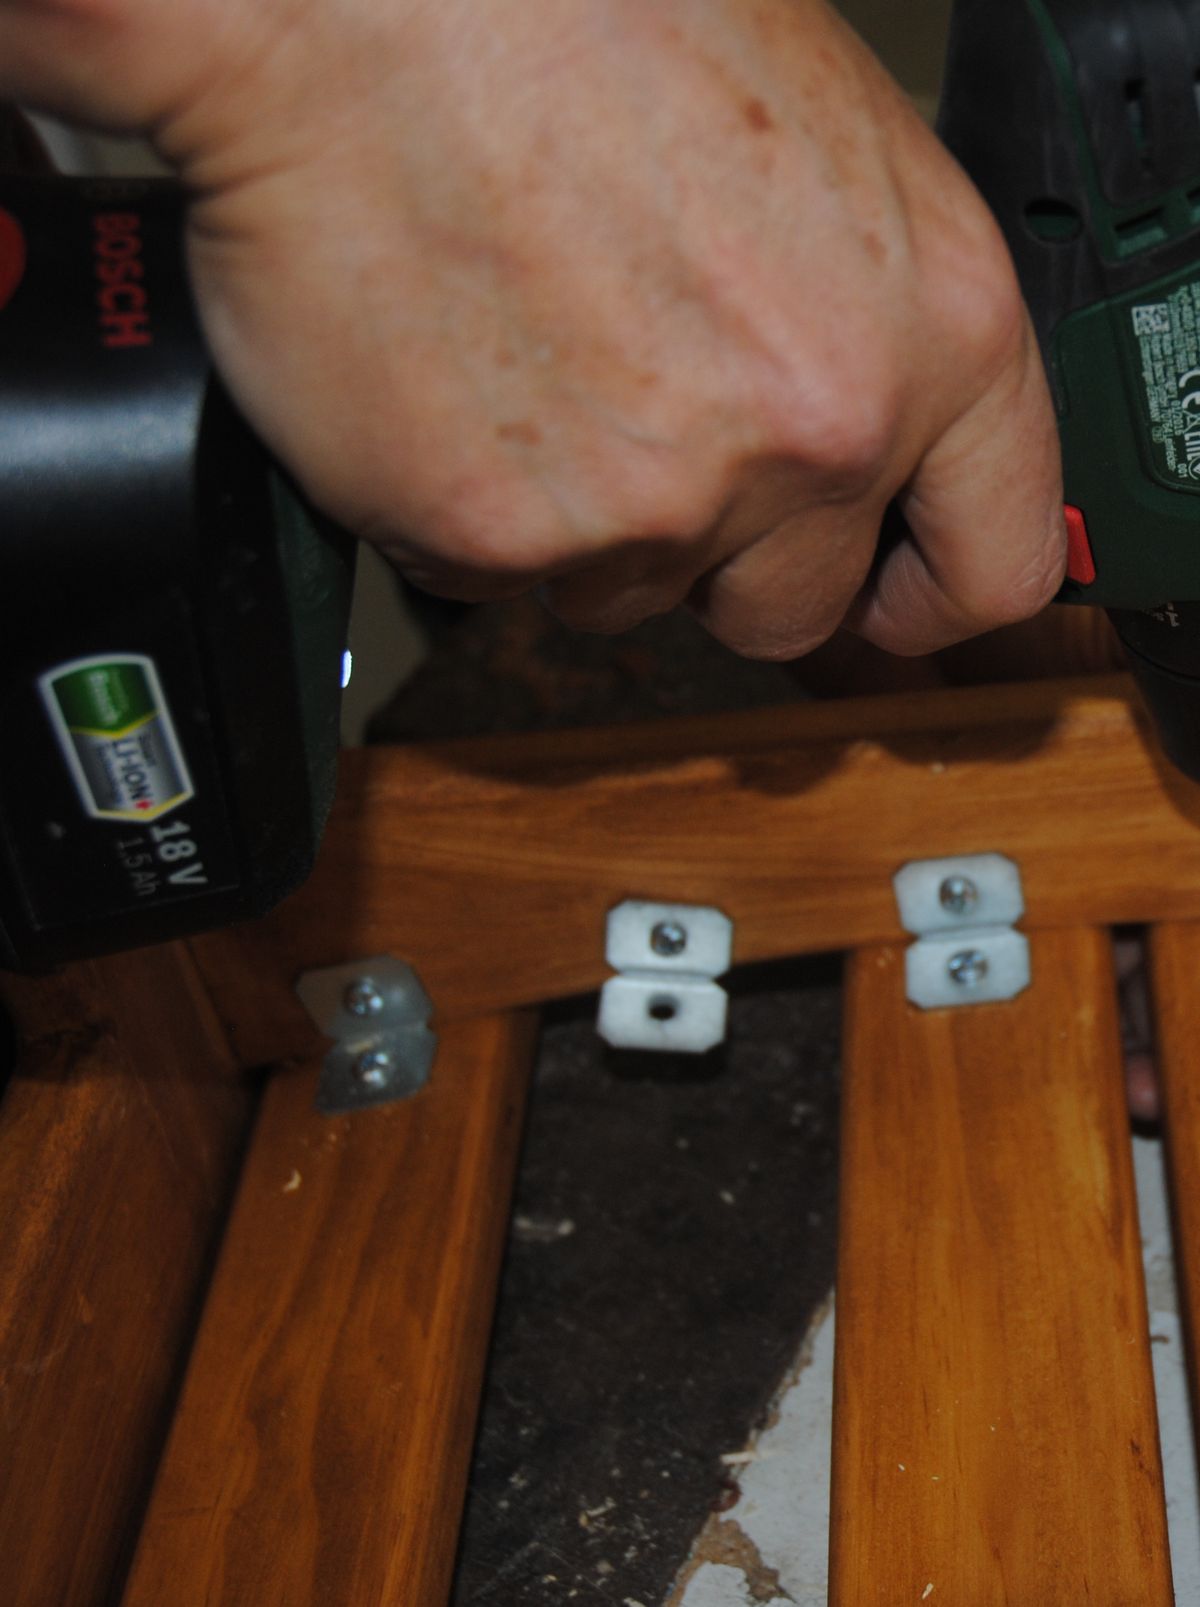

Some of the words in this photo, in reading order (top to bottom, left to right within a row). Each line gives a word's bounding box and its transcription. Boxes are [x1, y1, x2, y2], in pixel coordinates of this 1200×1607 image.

[94, 212, 153, 347] BOSCH
[151, 820, 197, 862] 18
[168, 862, 208, 885] V
